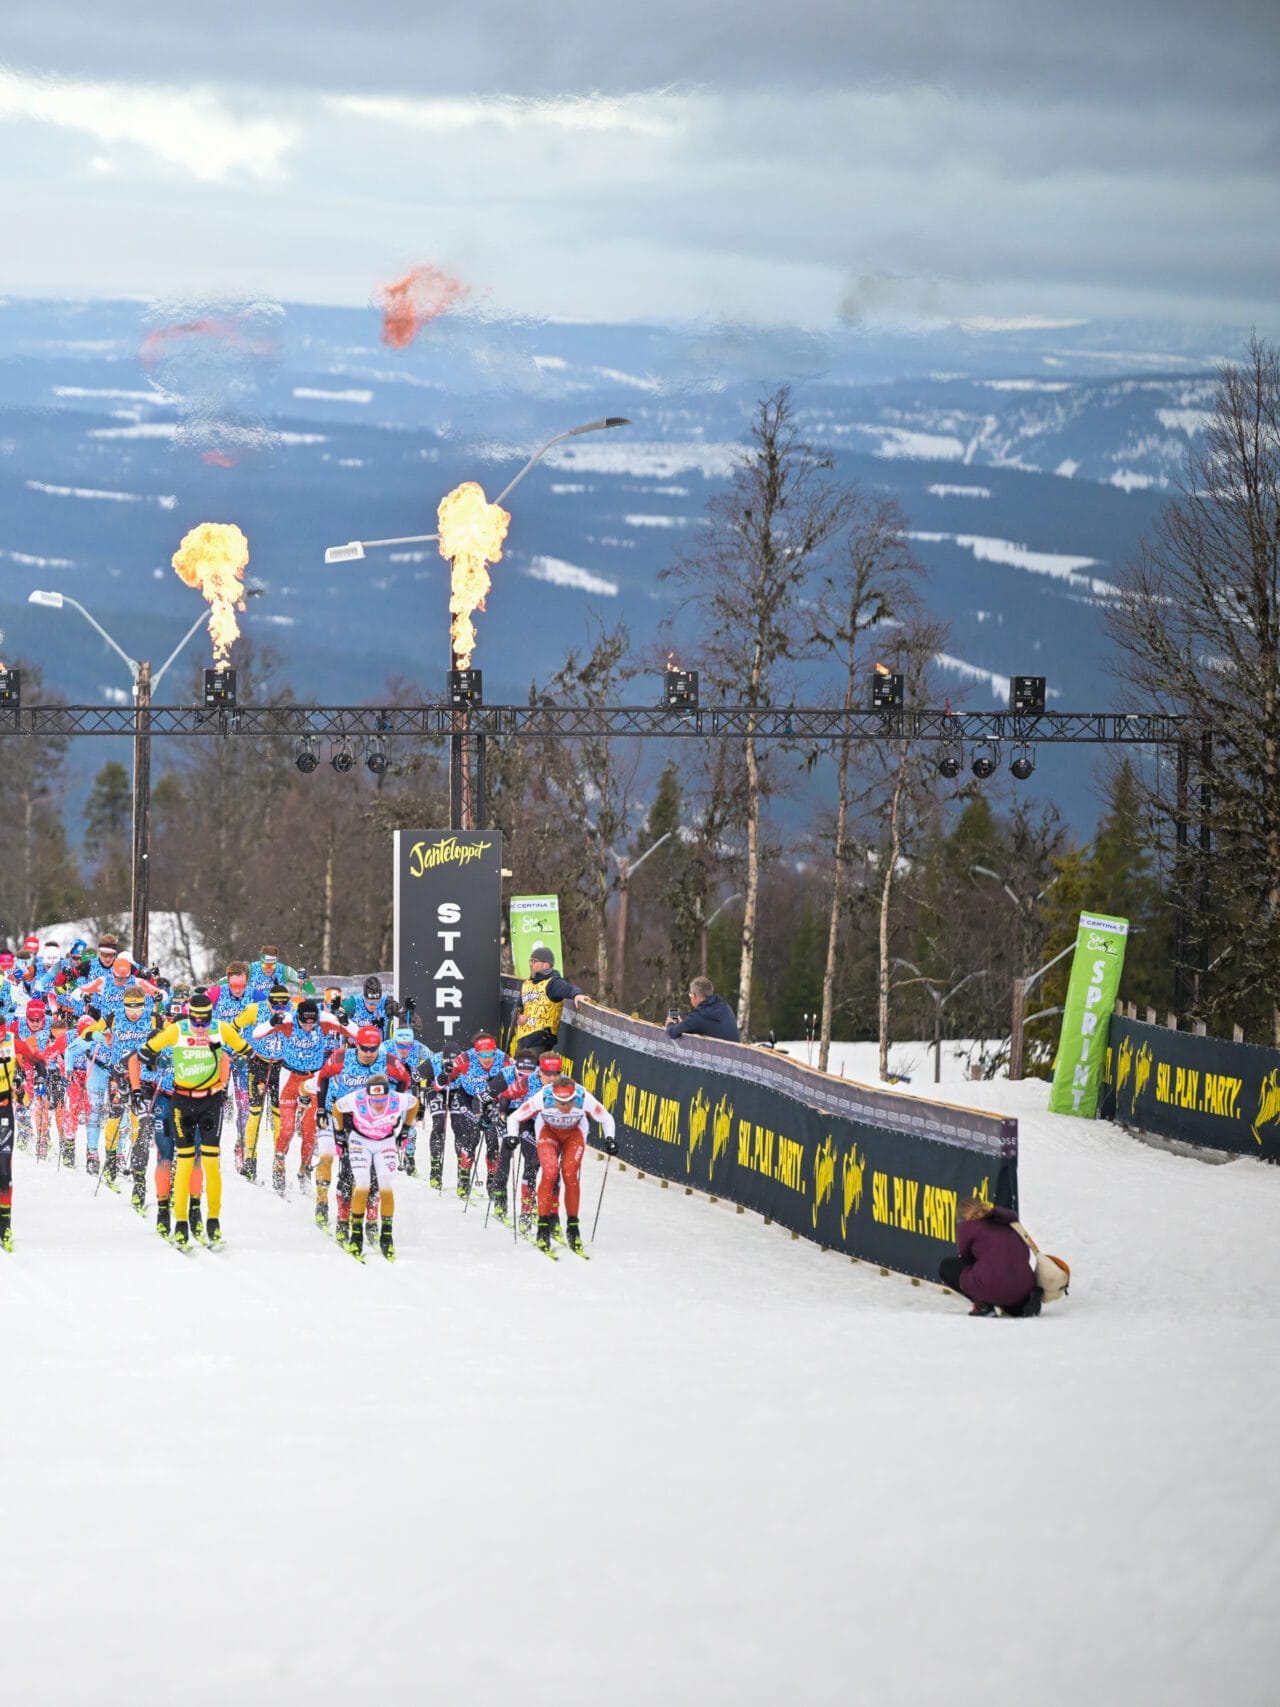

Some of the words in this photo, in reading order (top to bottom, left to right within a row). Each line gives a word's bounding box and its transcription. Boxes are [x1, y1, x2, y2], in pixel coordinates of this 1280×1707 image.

[410, 837, 492, 877] Janteloppet
[433, 902, 465, 1036] START
[182, 1049, 213, 1060] SPRIN
[1072, 960, 1106, 1111] SPRINT
